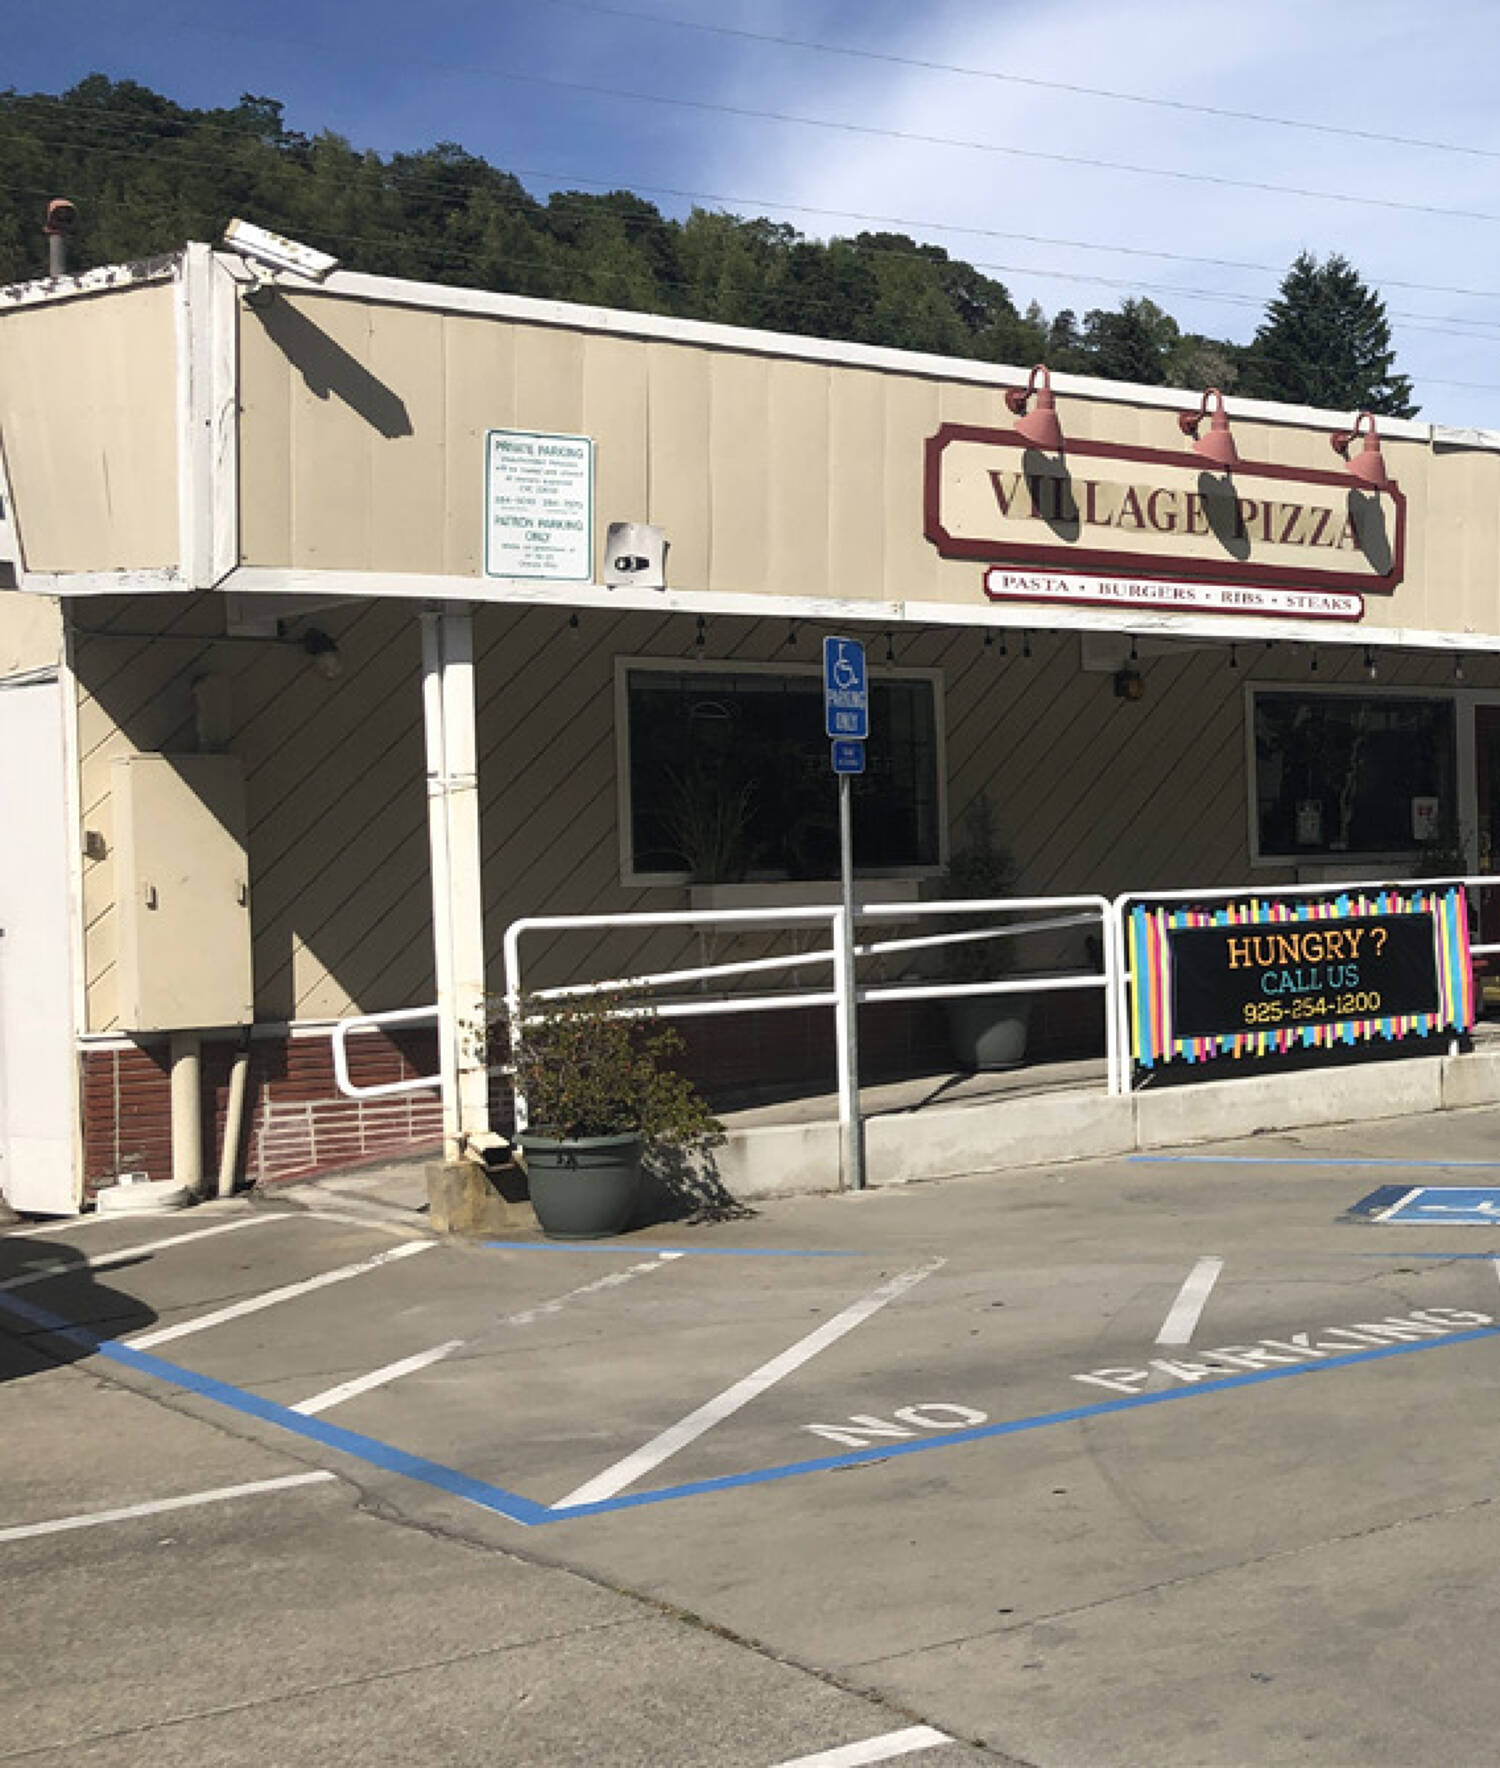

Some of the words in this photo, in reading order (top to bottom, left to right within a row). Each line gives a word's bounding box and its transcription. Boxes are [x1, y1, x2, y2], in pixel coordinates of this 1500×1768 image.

[538, 445, 584, 459] PARKING
[538, 519, 584, 531] PARKING
[987, 469, 1209, 535] VILLAGE
[1232, 498, 1366, 551] PIZZA
[525, 530, 551, 543] ONLY
[1002, 575, 1070, 593] PASTA
[1099, 582, 1196, 601] BURGERS
[1221, 591, 1265, 605] RIBS
[1286, 595, 1353, 611] STEAKS
[1226, 928, 1365, 970] HUNGRY
[1261, 969, 1323, 996] CALL
[1329, 964, 1361, 989] US
[1244, 992, 1382, 1025] 925-254-1200
[802, 1402, 989, 1448] NO
[1071, 1306, 1496, 1395] PARKING
